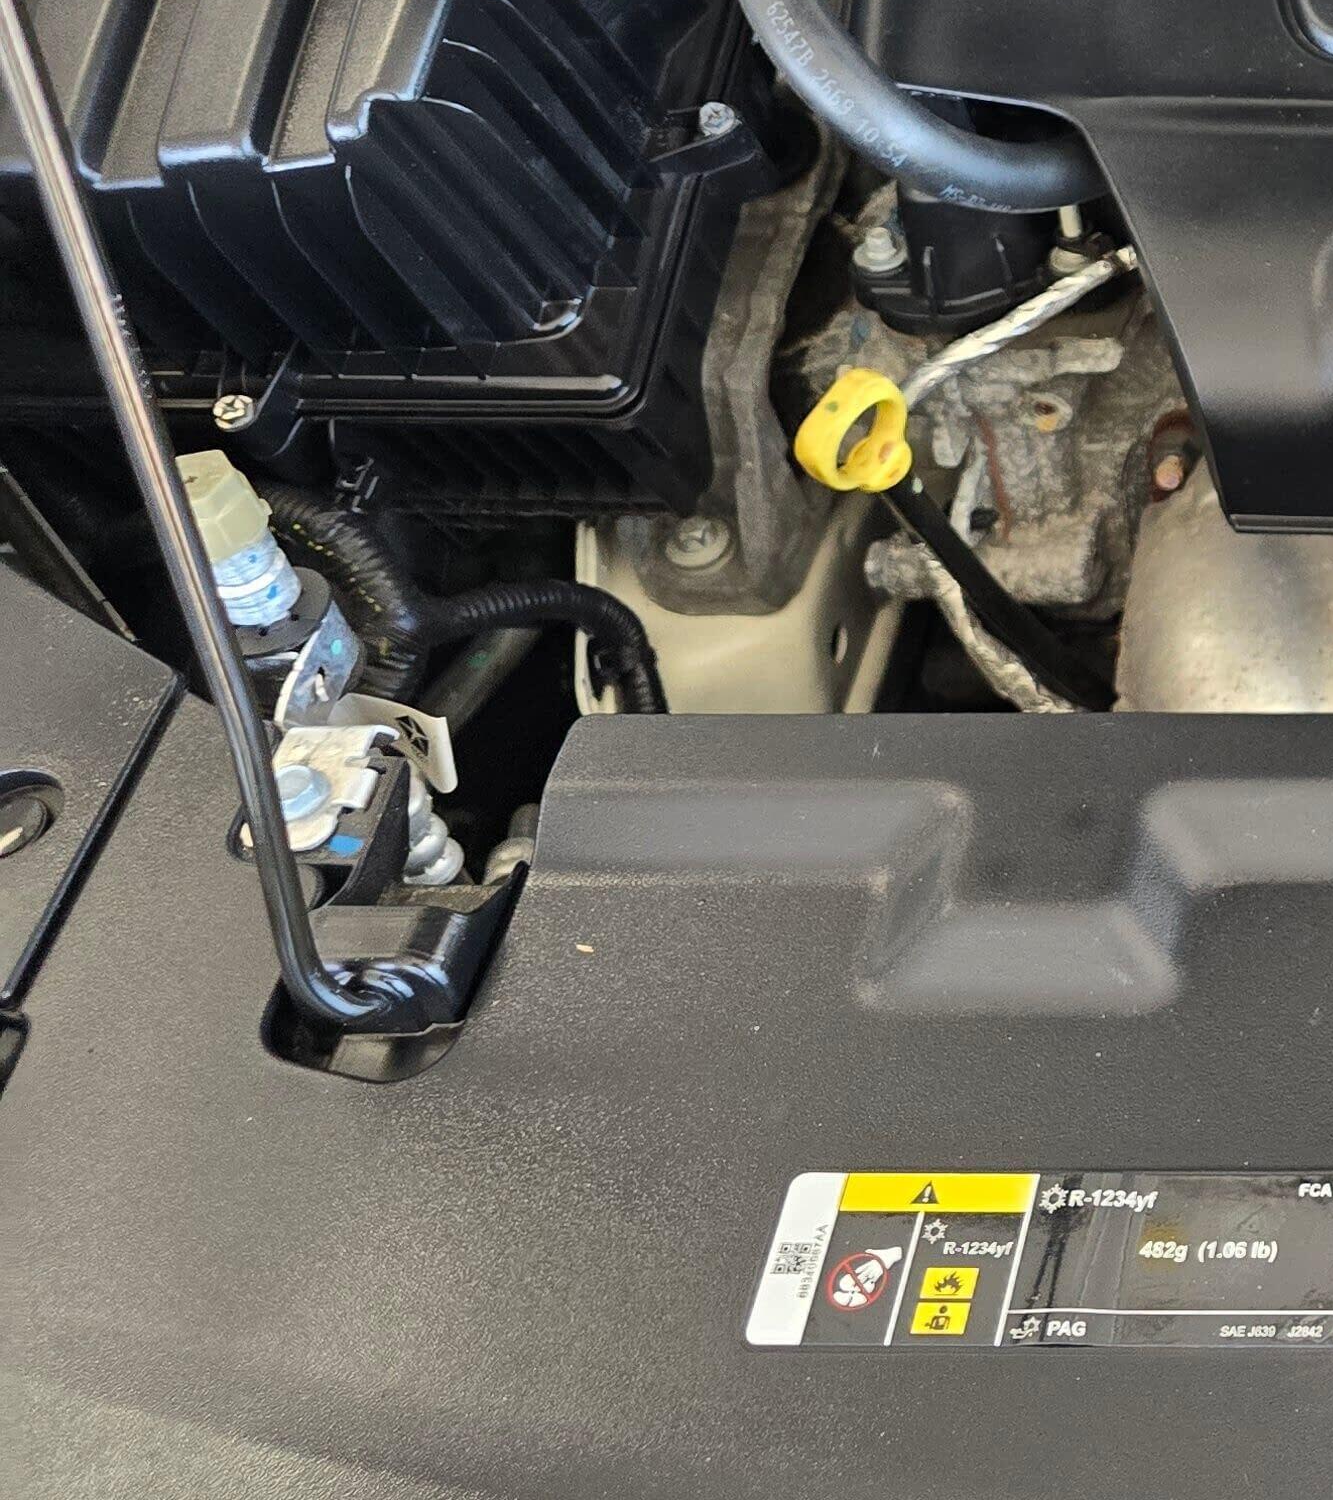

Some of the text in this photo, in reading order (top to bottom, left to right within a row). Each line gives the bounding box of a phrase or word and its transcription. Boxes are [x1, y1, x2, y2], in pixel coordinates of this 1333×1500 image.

[1298, 1183, 1332, 1198] FCA
[1068, 1189, 1158, 1212] R-1234yf
[943, 1241, 1014, 1259] R-1234yf
[1138, 1240, 1279, 1263] 482g (1.06 lb)
[1046, 1320, 1087, 1337] PAG
[1219, 1324, 1247, 1338] SAE
